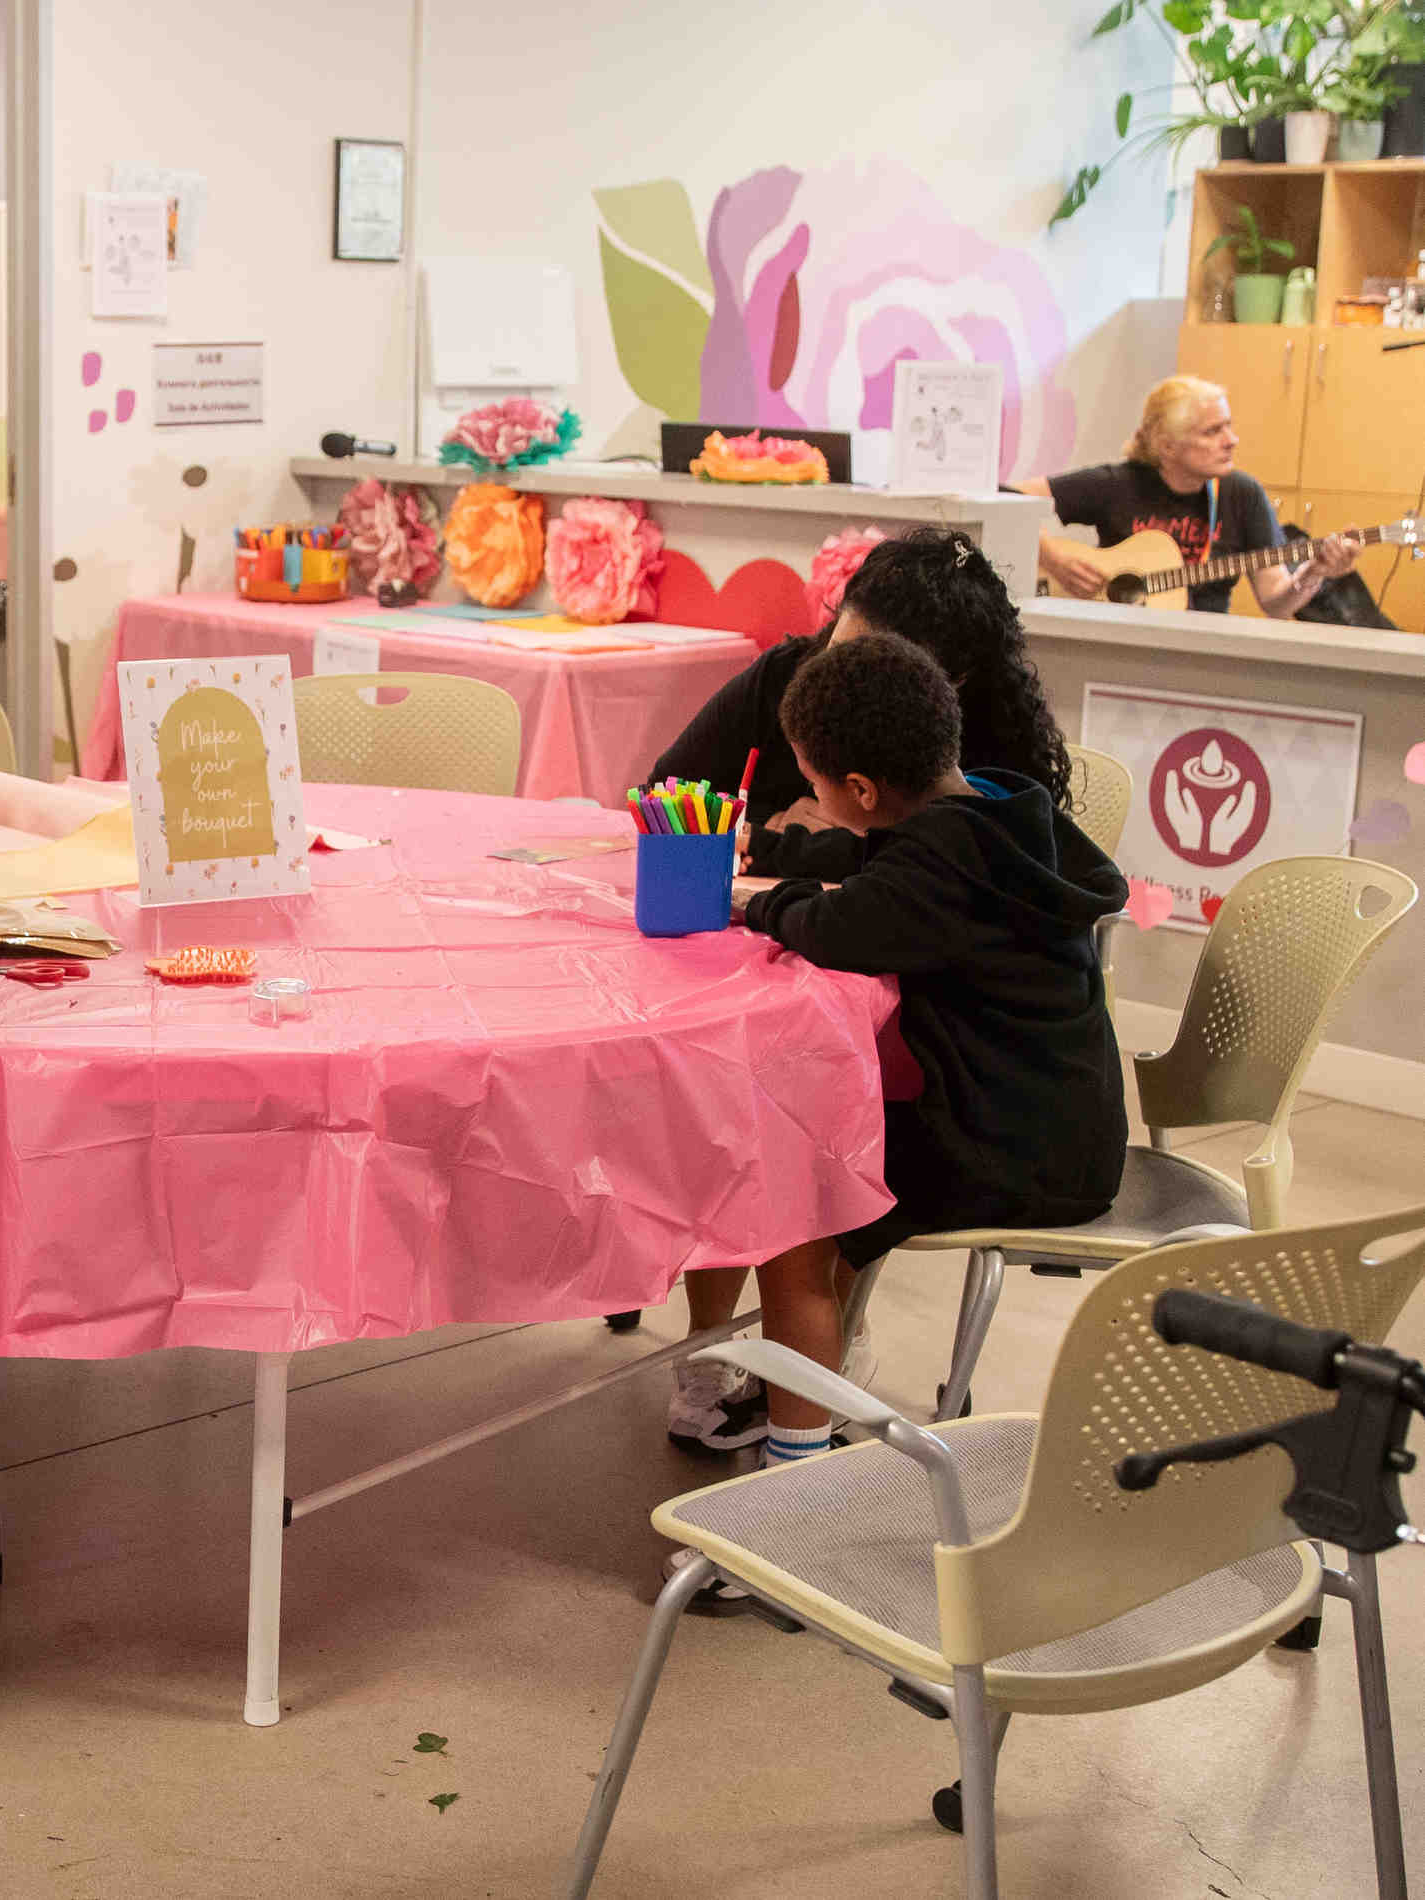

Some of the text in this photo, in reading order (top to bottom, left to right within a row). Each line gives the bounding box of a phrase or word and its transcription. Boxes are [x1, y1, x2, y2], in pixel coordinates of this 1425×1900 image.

[180, 719, 242, 759] Make
[191, 758, 237, 791] your
[198, 789, 236, 803] own
[182, 800, 264, 849] bouquet
